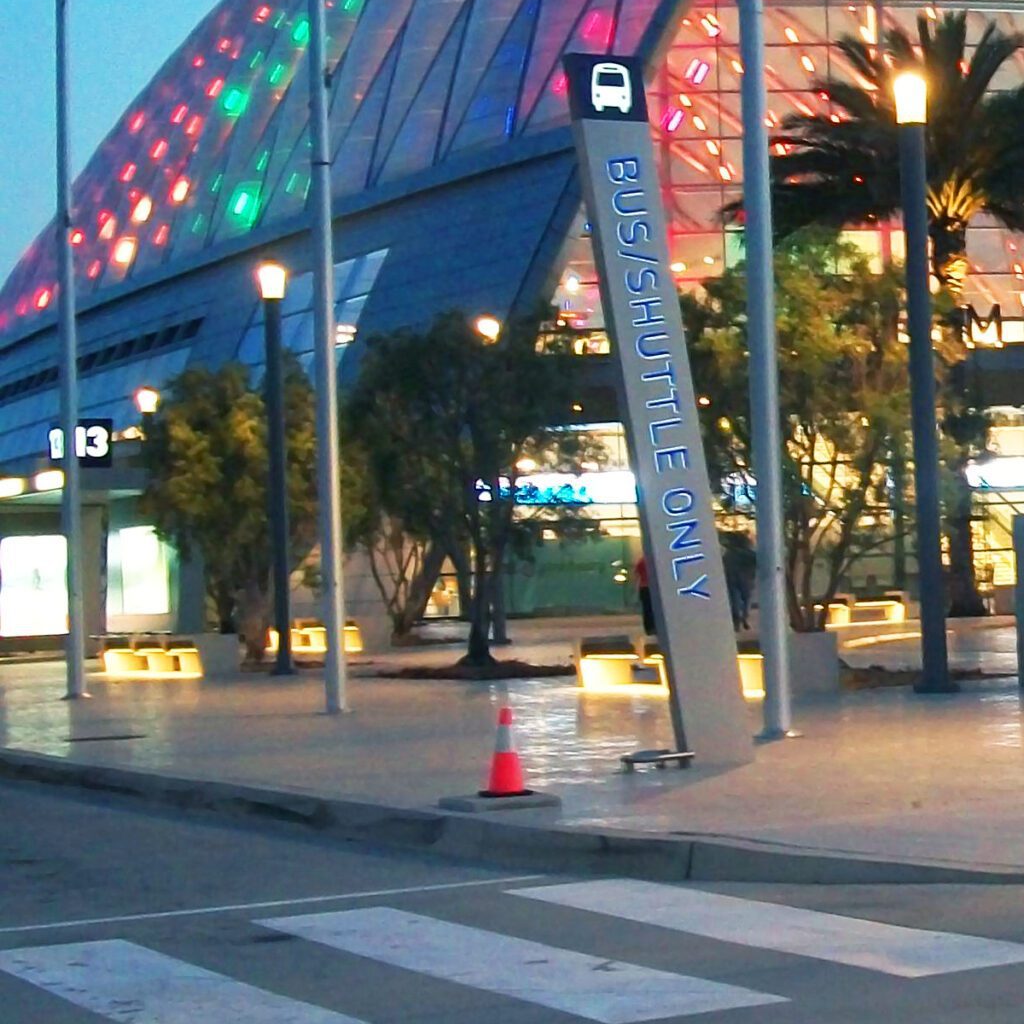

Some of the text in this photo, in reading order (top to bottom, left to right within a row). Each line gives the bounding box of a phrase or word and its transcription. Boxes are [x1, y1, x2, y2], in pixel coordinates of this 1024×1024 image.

[75, 425, 109, 458] 13
[606, 157, 711, 601] BUS/SHUTTLE ONLY
